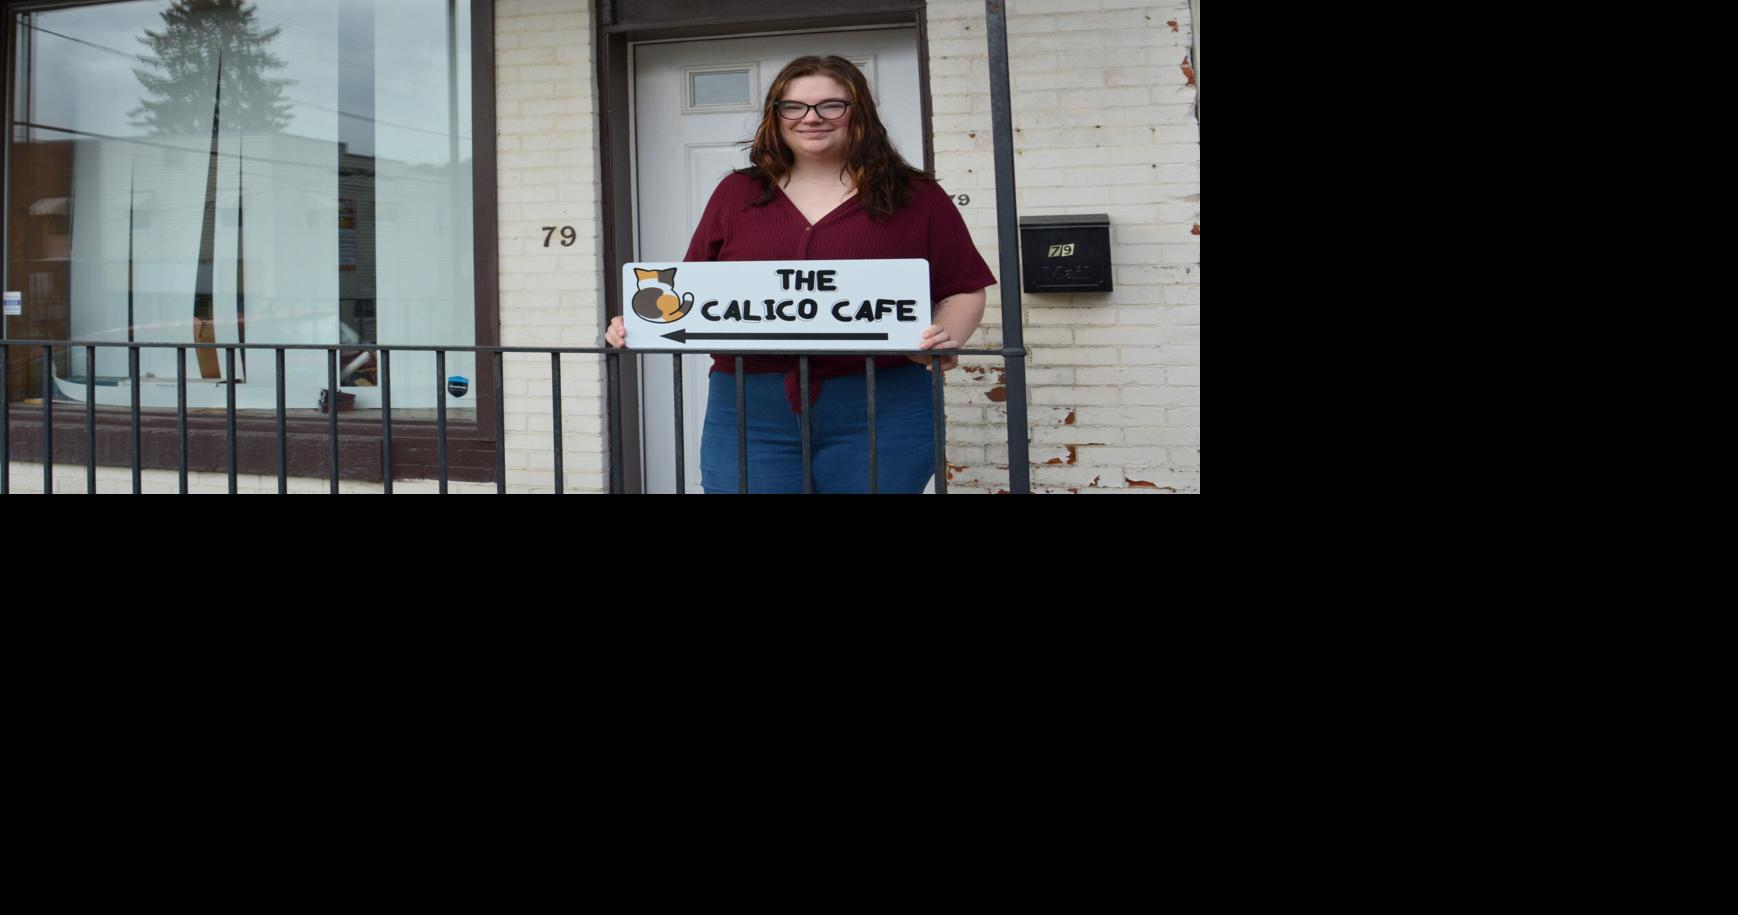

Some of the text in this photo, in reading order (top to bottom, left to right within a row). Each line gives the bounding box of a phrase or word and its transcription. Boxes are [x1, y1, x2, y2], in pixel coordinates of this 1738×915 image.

[542, 225, 577, 248] 79
[1050, 244, 1073, 256] 79
[776, 268, 838, 292] THE
[700, 298, 918, 323] CALICO CAFE
